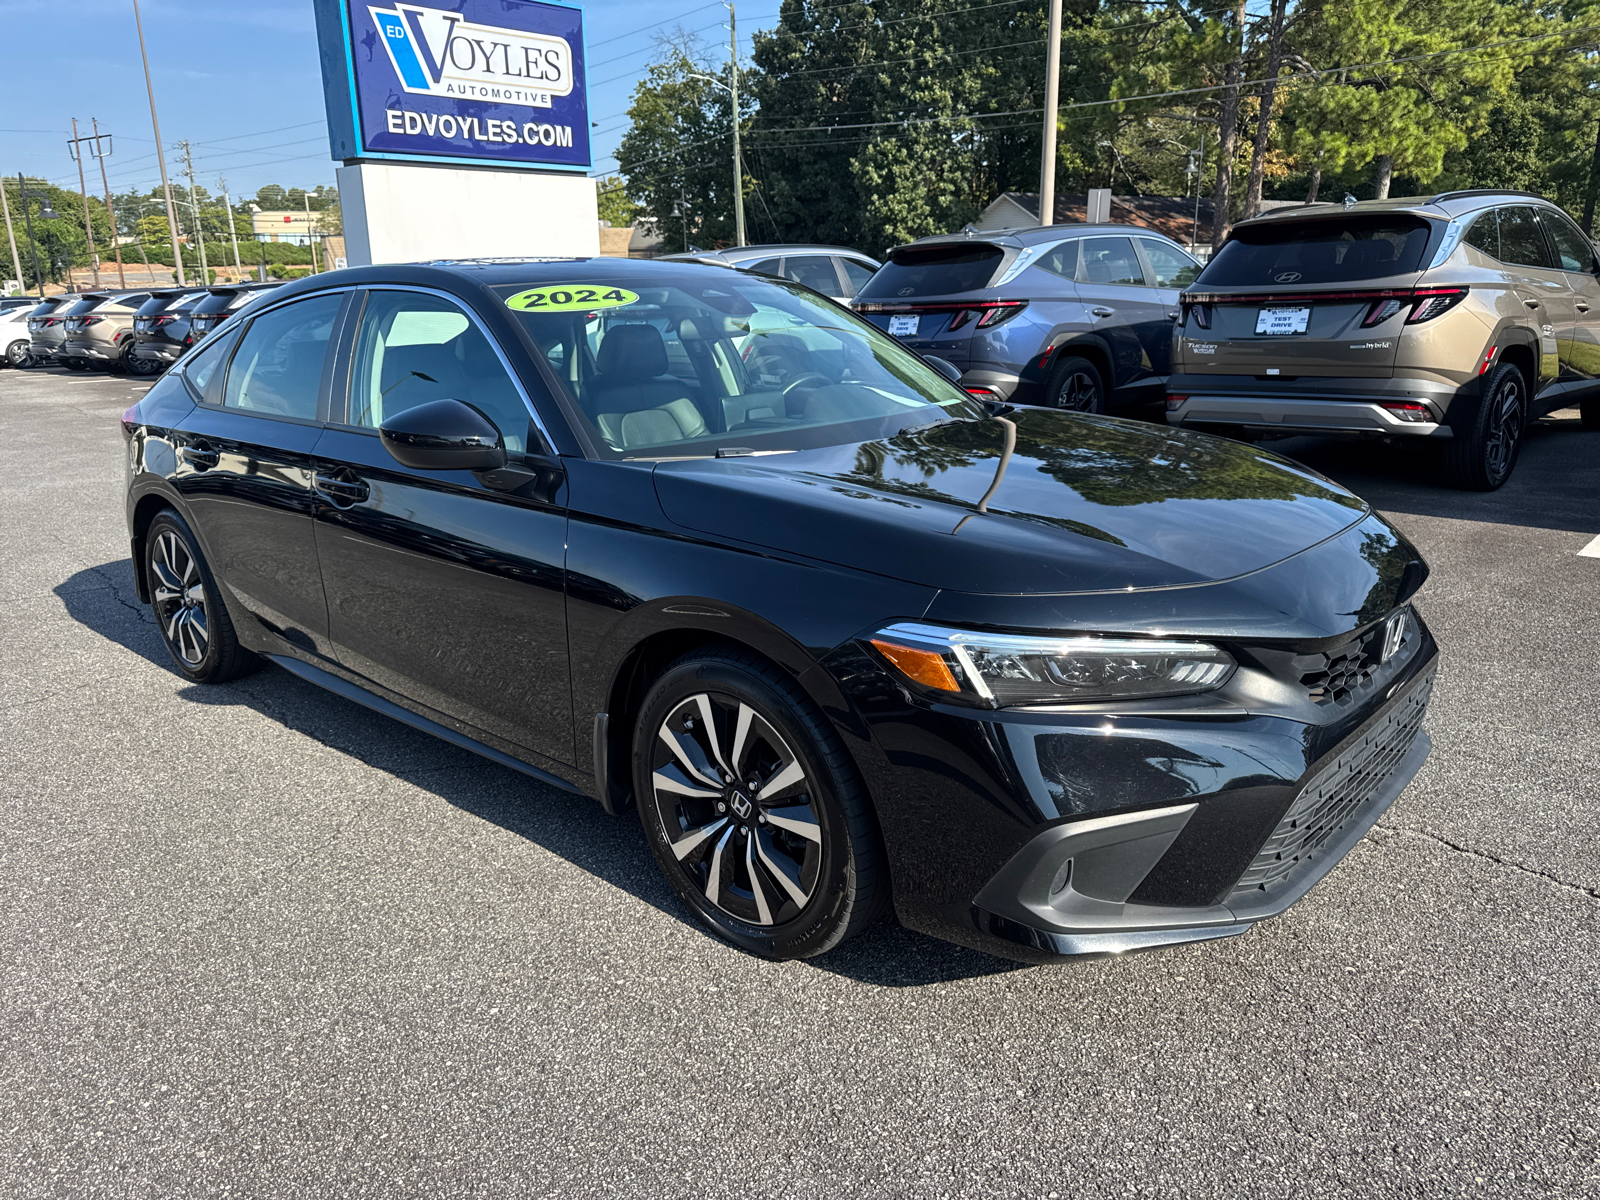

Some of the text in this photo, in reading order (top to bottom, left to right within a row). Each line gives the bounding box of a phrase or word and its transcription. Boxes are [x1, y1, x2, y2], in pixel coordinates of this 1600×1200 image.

[386, 9, 561, 82] ED VOYLES
[446, 83, 548, 104] AUTOMOTIVE
[386, 109, 573, 148] EDVOYLES.COM
[523, 290, 626, 308] 2024
